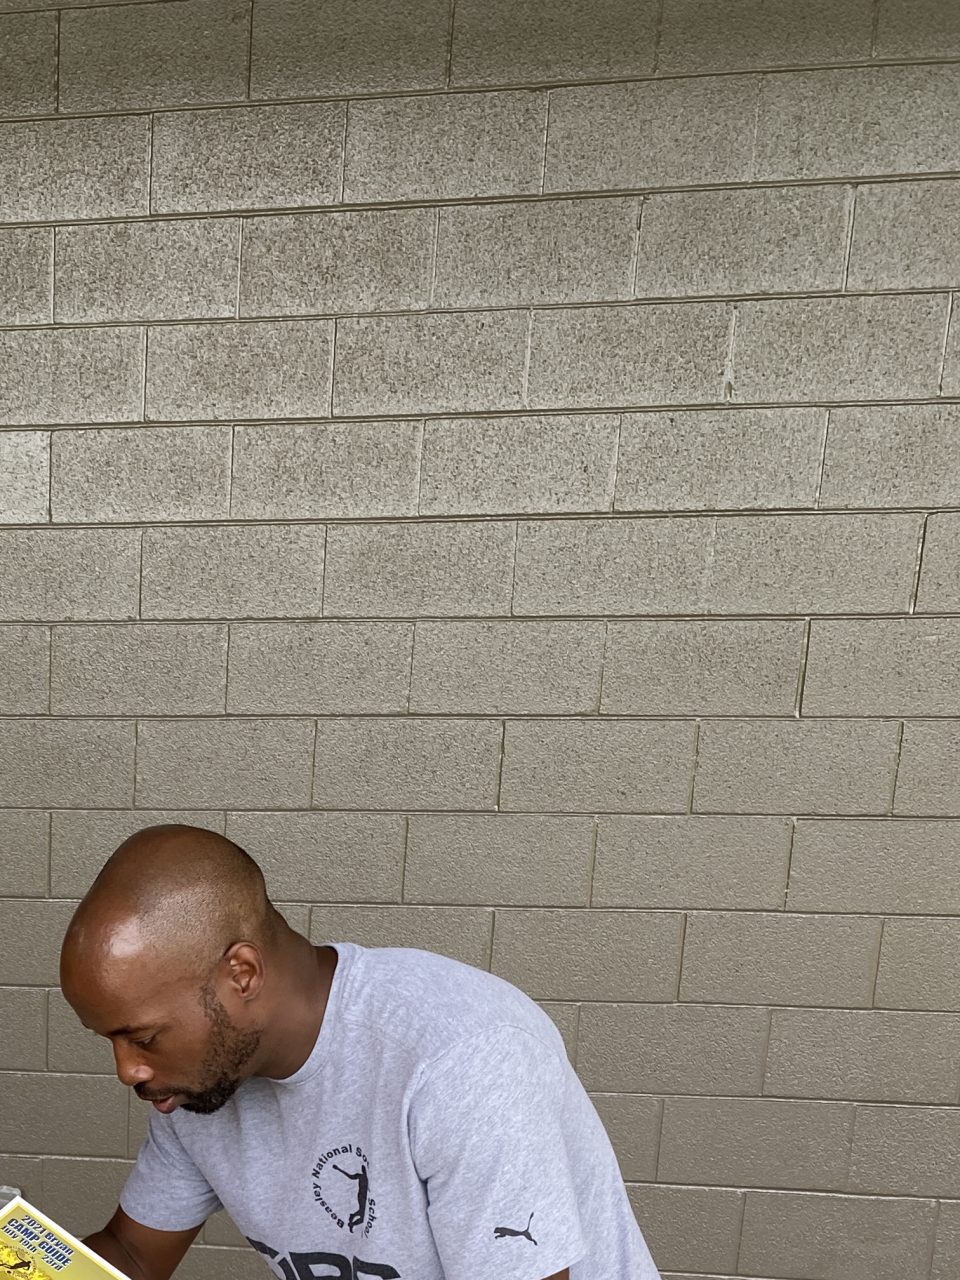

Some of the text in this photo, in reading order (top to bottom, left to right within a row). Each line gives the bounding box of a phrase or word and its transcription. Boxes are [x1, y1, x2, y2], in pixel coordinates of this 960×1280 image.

[311, 1143, 353, 1229] Beasley National
[1, 1225, 19, 1240] July
[19, 1237, 38, 1253] 19th
[41, 1253, 63, 1271] 23rd
[7, 1218, 40, 1241] CAMP
[38, 1240, 72, 1267] GUIDE
[21, 1215, 74, 1256] 2021 Bryan
